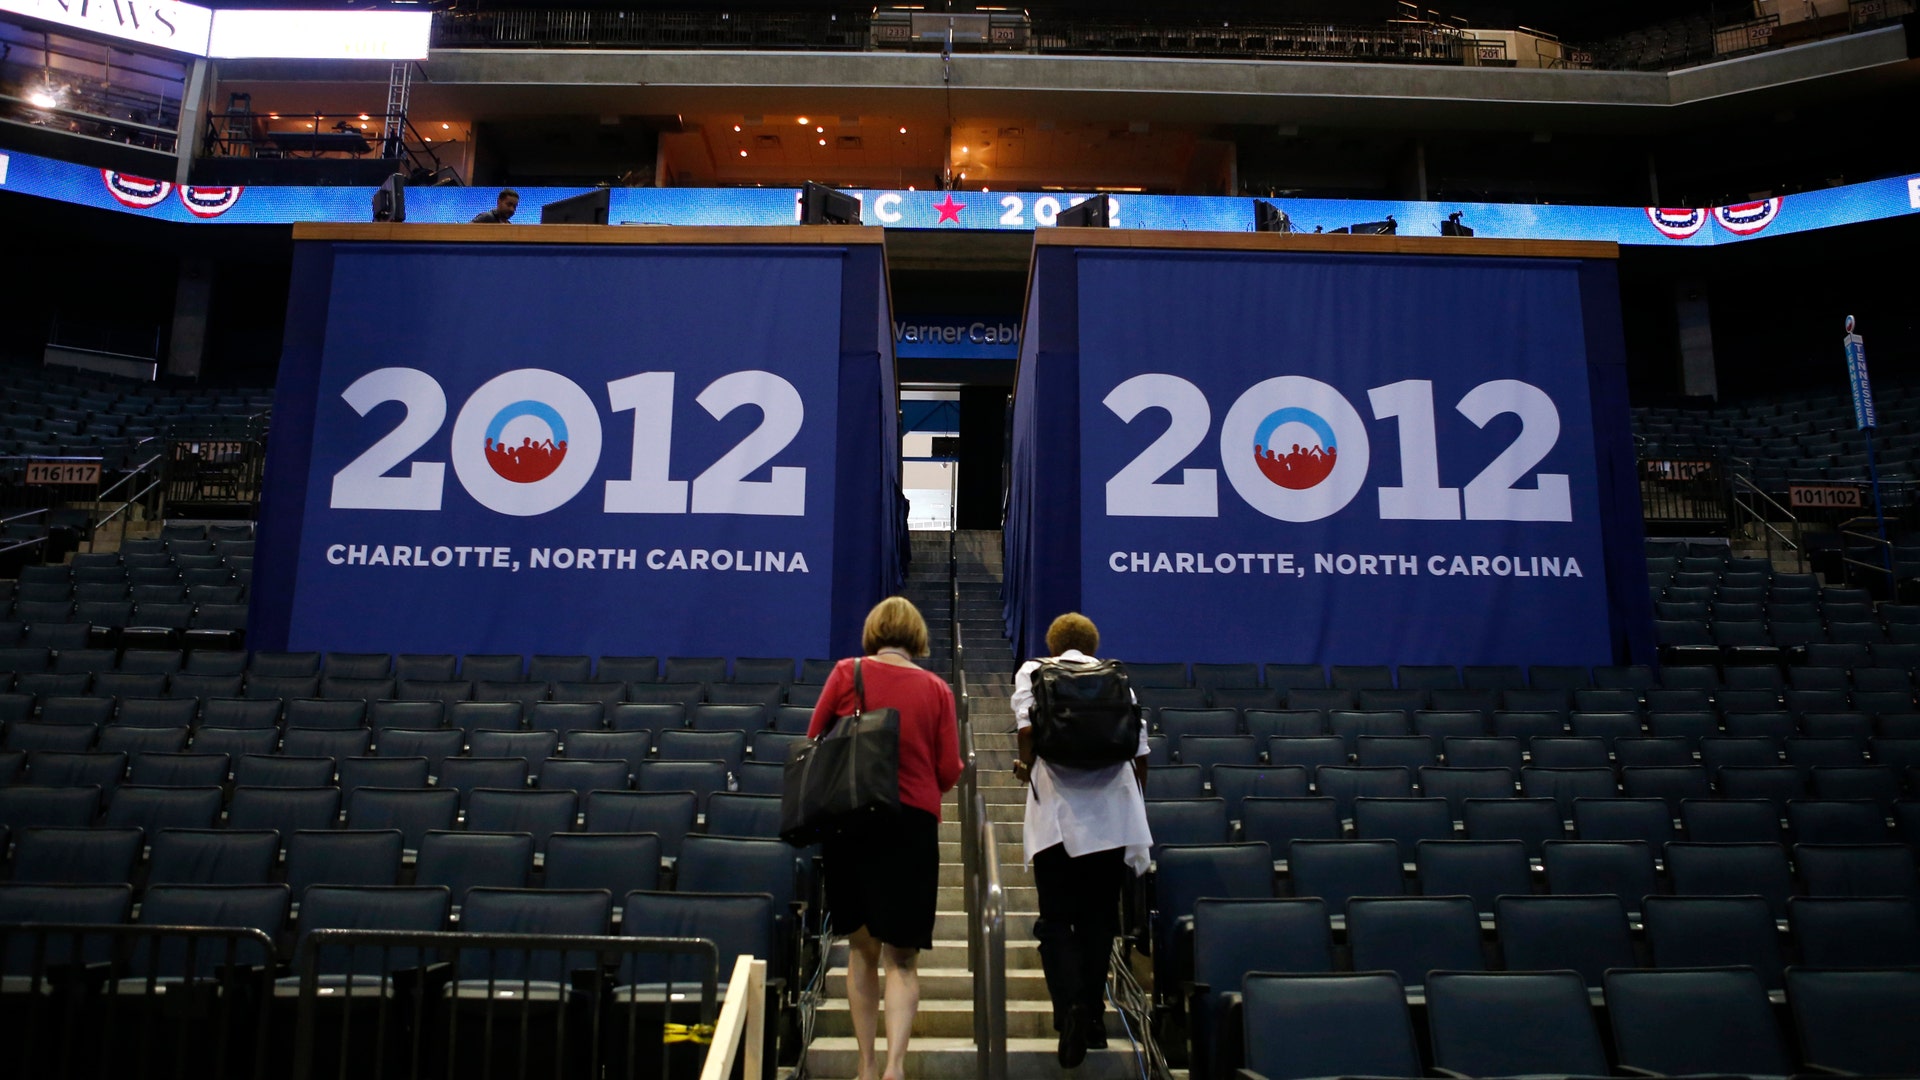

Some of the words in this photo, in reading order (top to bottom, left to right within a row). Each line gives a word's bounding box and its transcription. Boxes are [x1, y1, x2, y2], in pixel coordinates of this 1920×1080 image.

[888, 28, 905, 37] 233
[997, 31, 1013, 40] 201
[1752, 28, 1771, 38] 202
[1482, 50, 1499, 58] 201
[1001, 195, 1120, 227] 202
[969, 322, 1020, 341] Cabl
[1846, 344, 1864, 427] TENNESSEE
[1854, 343, 1875, 426] TENNESSEE
[330, 367, 807, 517] 2012
[1102, 373, 1573, 523] 2012
[31, 467, 60, 480] 116
[66, 467, 96, 480] 117
[1795, 489, 1822, 503] 101
[1828, 490, 1856, 504] 102
[326, 544, 520, 572] CHARLOTTE,
[530, 547, 637, 570] NORTH
[646, 548, 809, 573] CAROLINA
[1109, 551, 1304, 578] CHARLOTTE,
[1314, 553, 1418, 576] NORTH
[1427, 555, 1583, 578] CAROLINA
